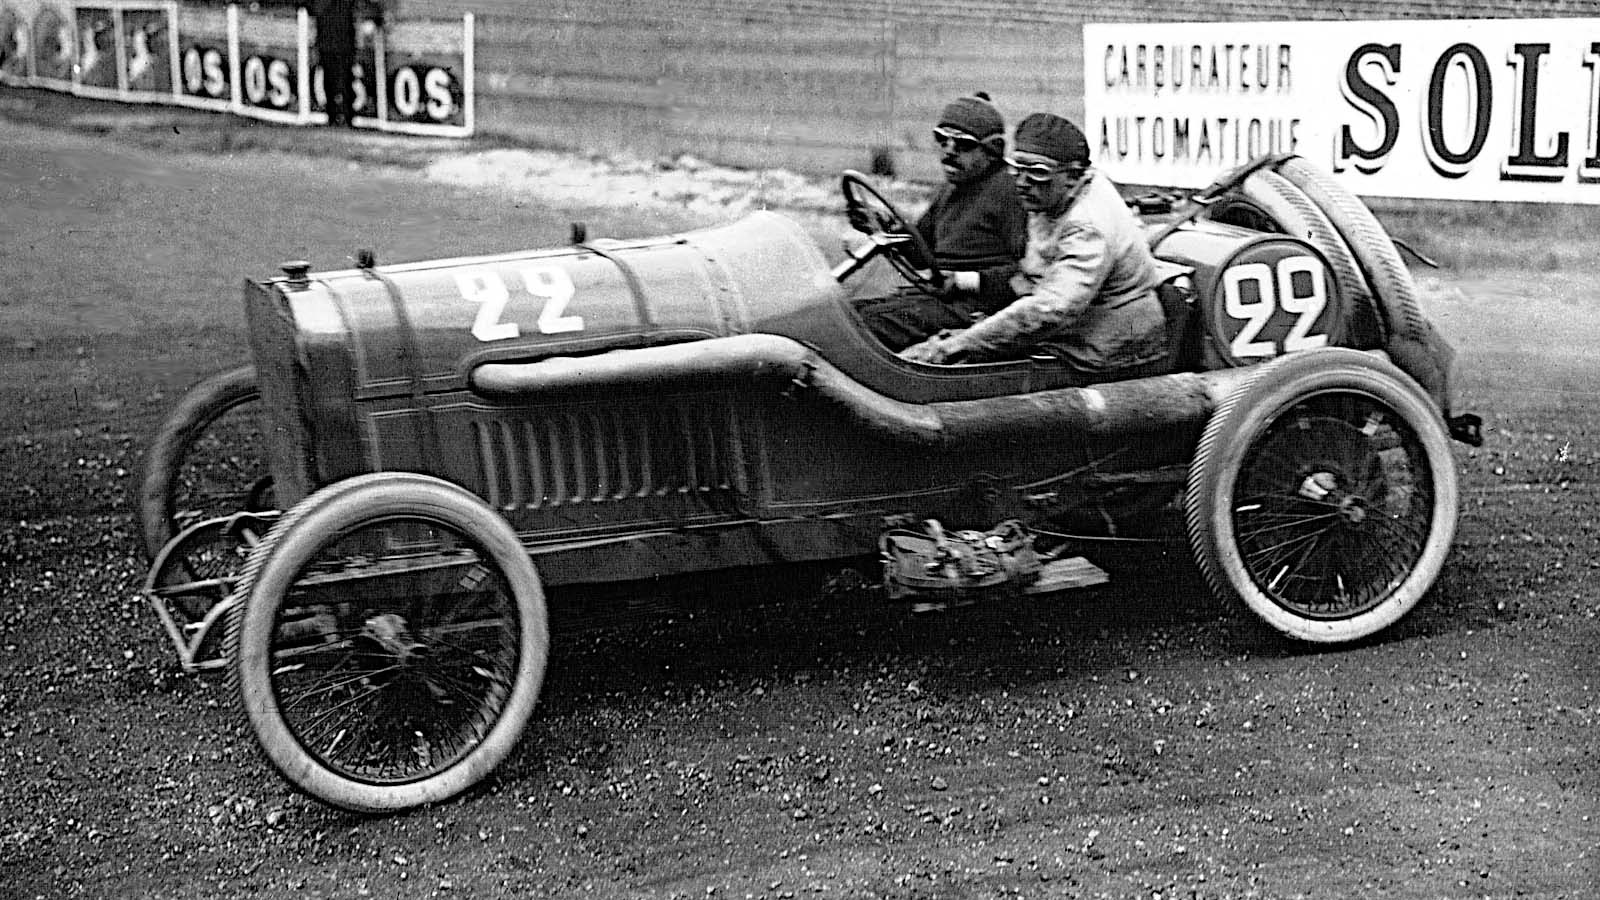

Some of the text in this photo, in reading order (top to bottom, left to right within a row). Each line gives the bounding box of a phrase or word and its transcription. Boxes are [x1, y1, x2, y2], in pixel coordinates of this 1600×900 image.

[245, 56, 291, 107] OS
[394, 66, 452, 119] OS
[1104, 44, 1292, 92] CARBURATEUR
[1335, 42, 1600, 184] SOL
[1099, 116, 1301, 165] AUTOMATIQUE
[453, 263, 585, 342] 22
[1224, 256, 1328, 357] 22
